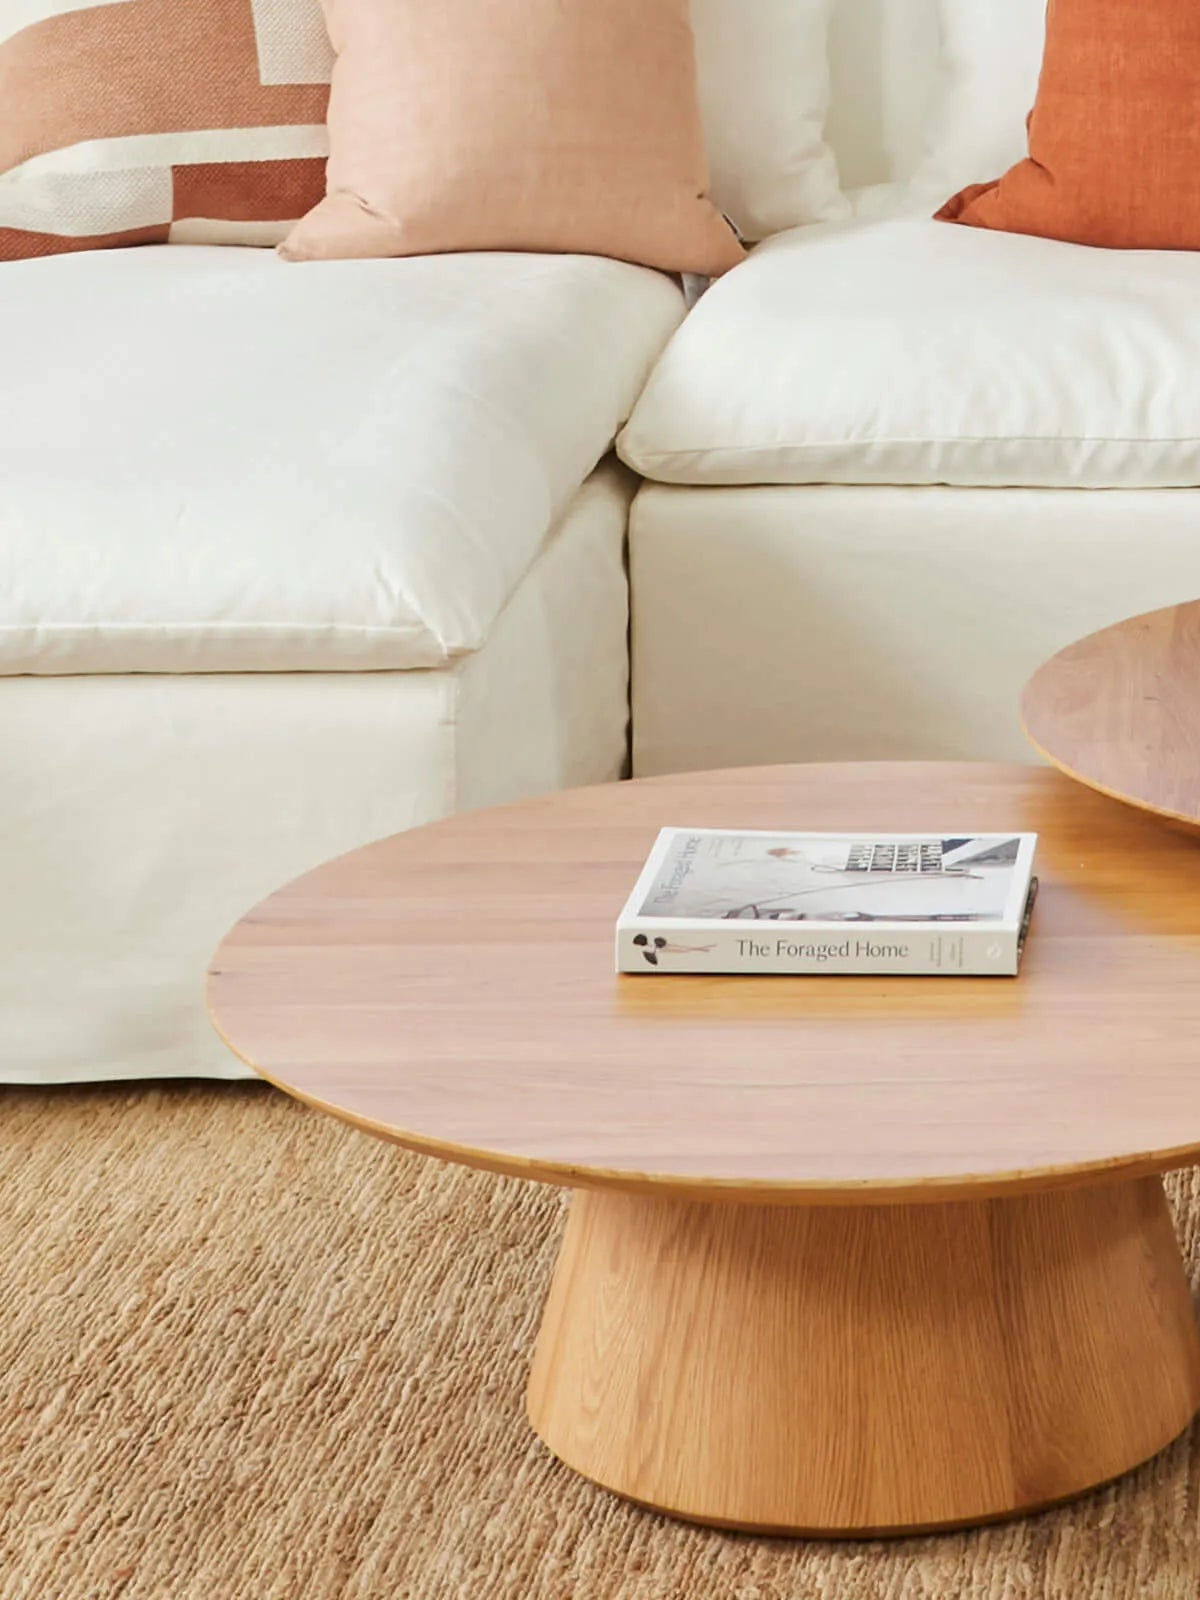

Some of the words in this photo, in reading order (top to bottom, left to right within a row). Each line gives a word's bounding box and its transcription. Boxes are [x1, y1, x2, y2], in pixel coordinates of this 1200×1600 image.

[736, 939, 770, 957] The
[776, 939, 849, 961] Foraged
[855, 940, 909, 958] Home
